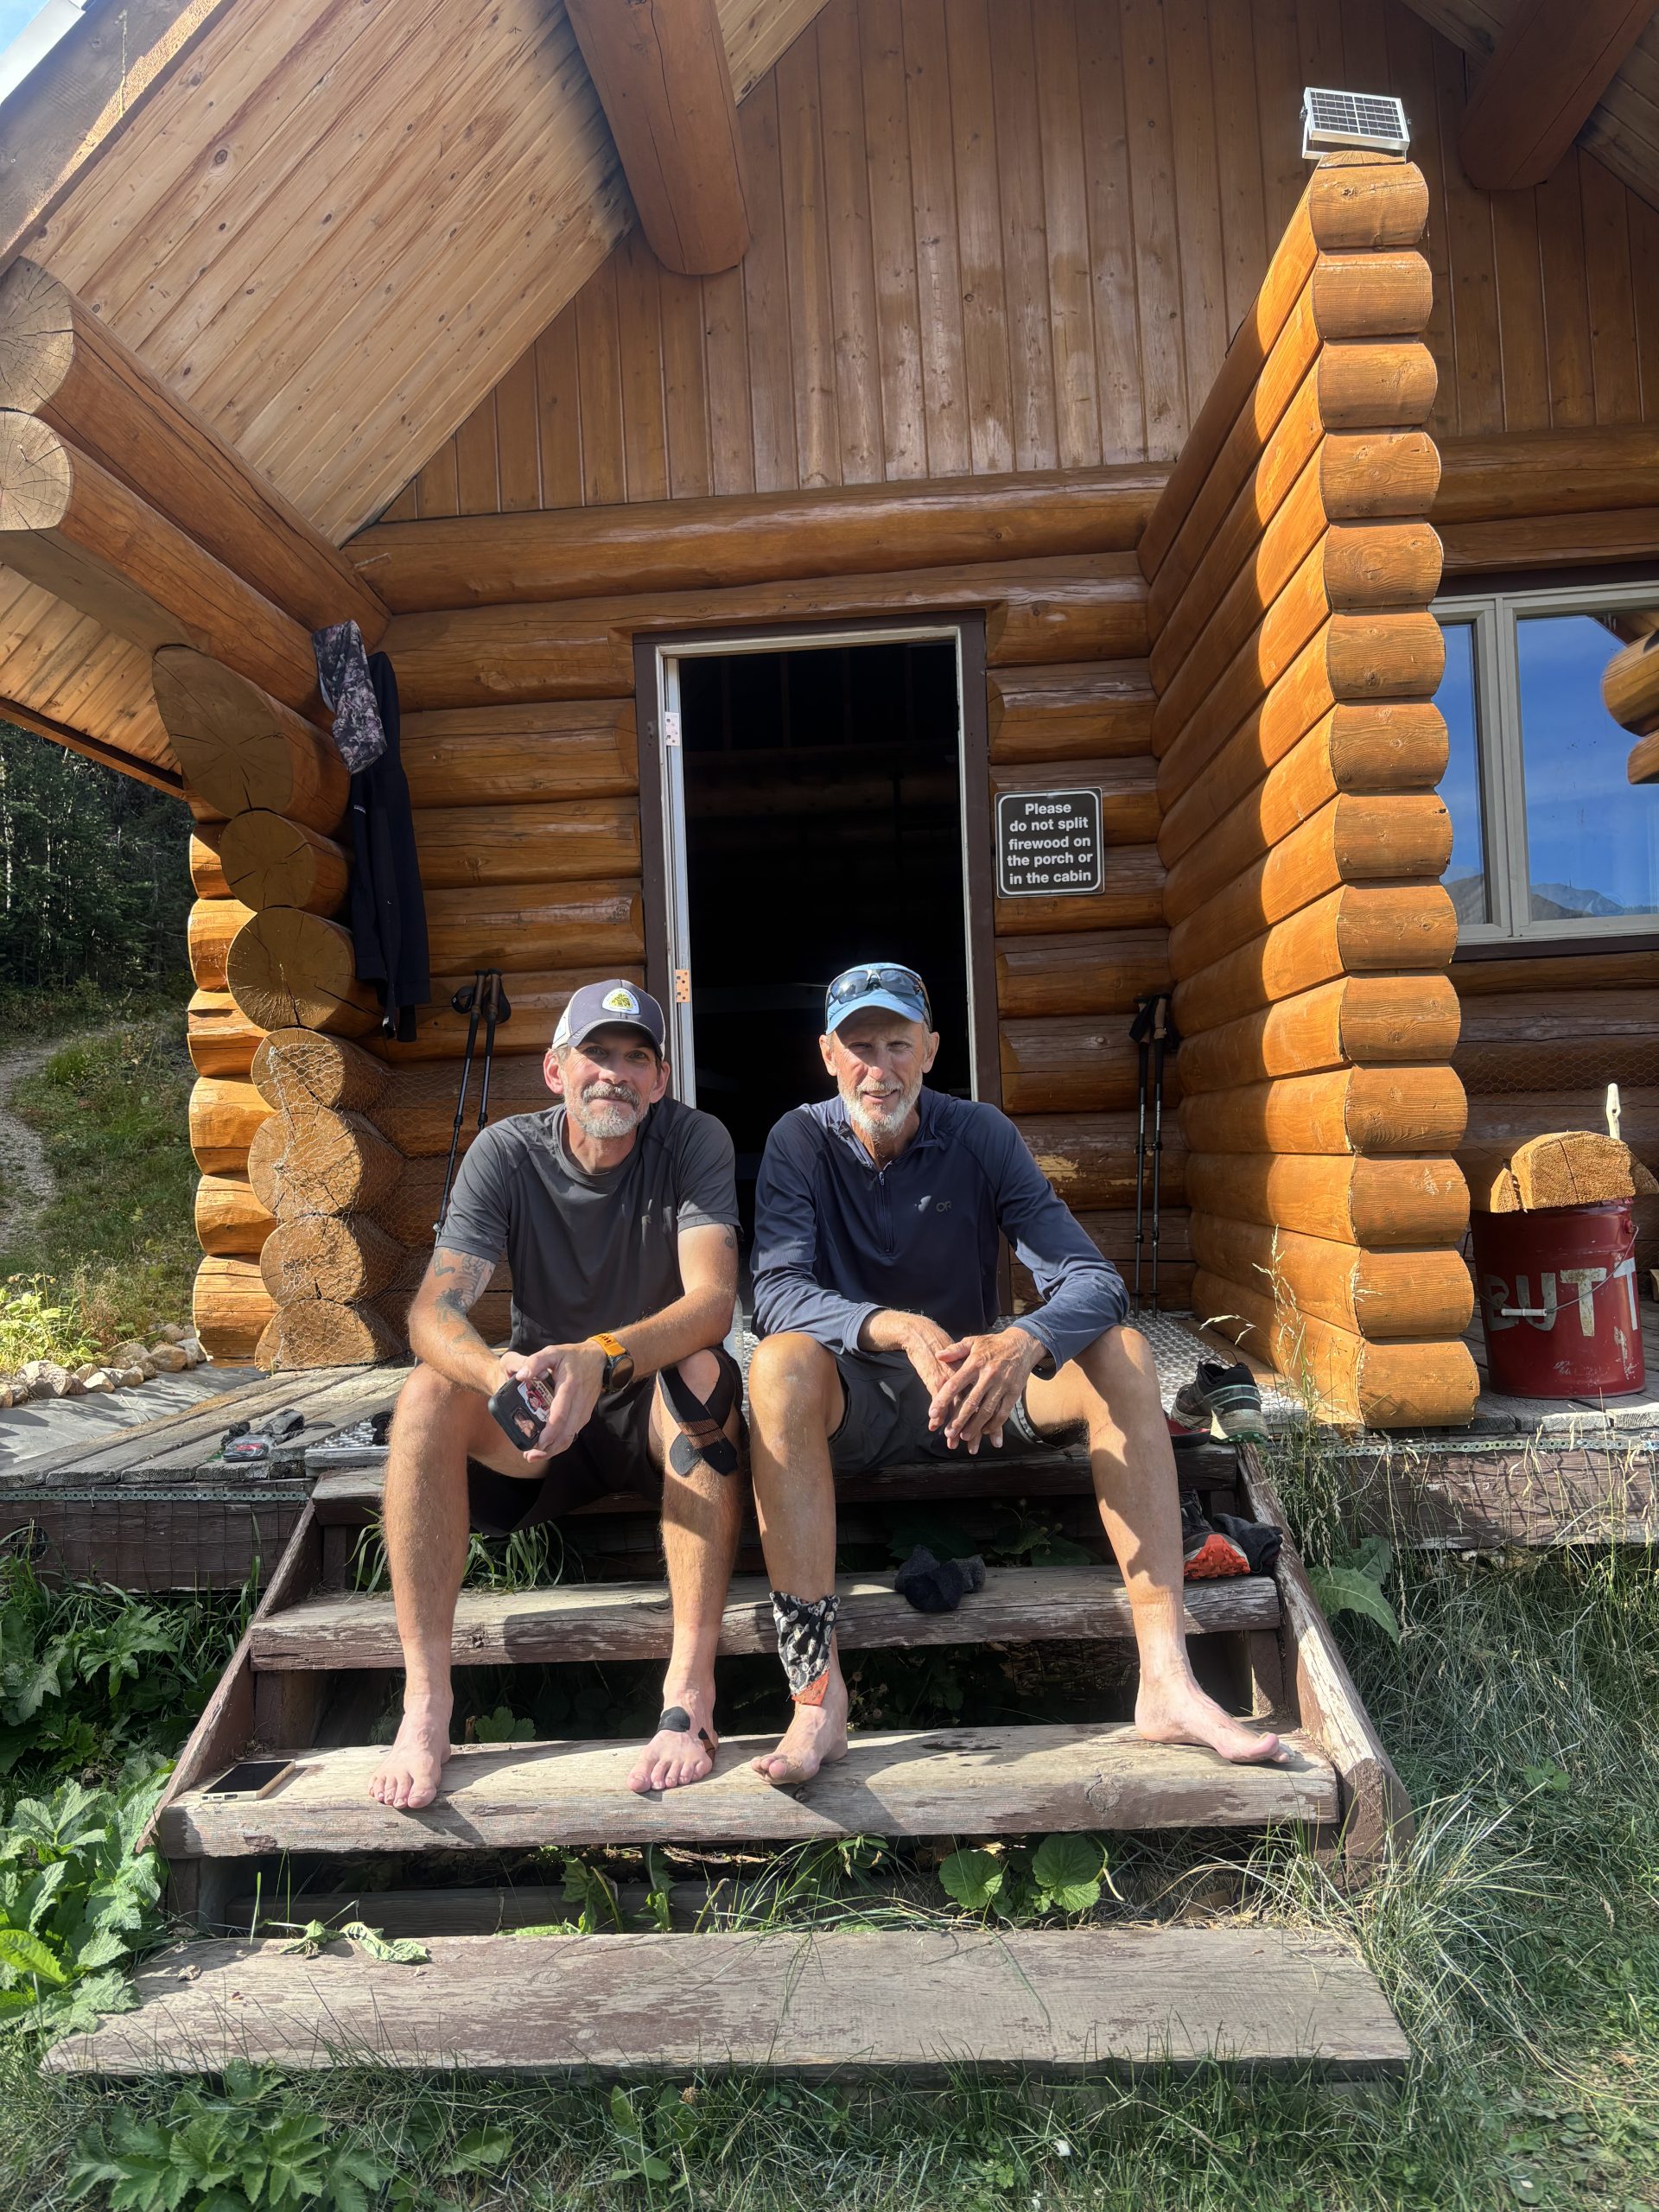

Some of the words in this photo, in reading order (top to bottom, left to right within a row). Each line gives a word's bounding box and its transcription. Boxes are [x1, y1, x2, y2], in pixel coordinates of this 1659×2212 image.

[1025, 804, 1072, 815] Please
[1009, 820, 1027, 832] do
[1031, 819, 1054, 831] not
[1058, 817, 1089, 831] split
[1008, 836, 1070, 850] firewood
[1073, 837, 1091, 847] on
[1007, 855, 1030, 867] the
[1034, 852, 1074, 868] porch
[1078, 853, 1093, 862] or
[1009, 873, 1023, 885] in
[1027, 872, 1049, 884] the
[1053, 870, 1091, 882] cabin
